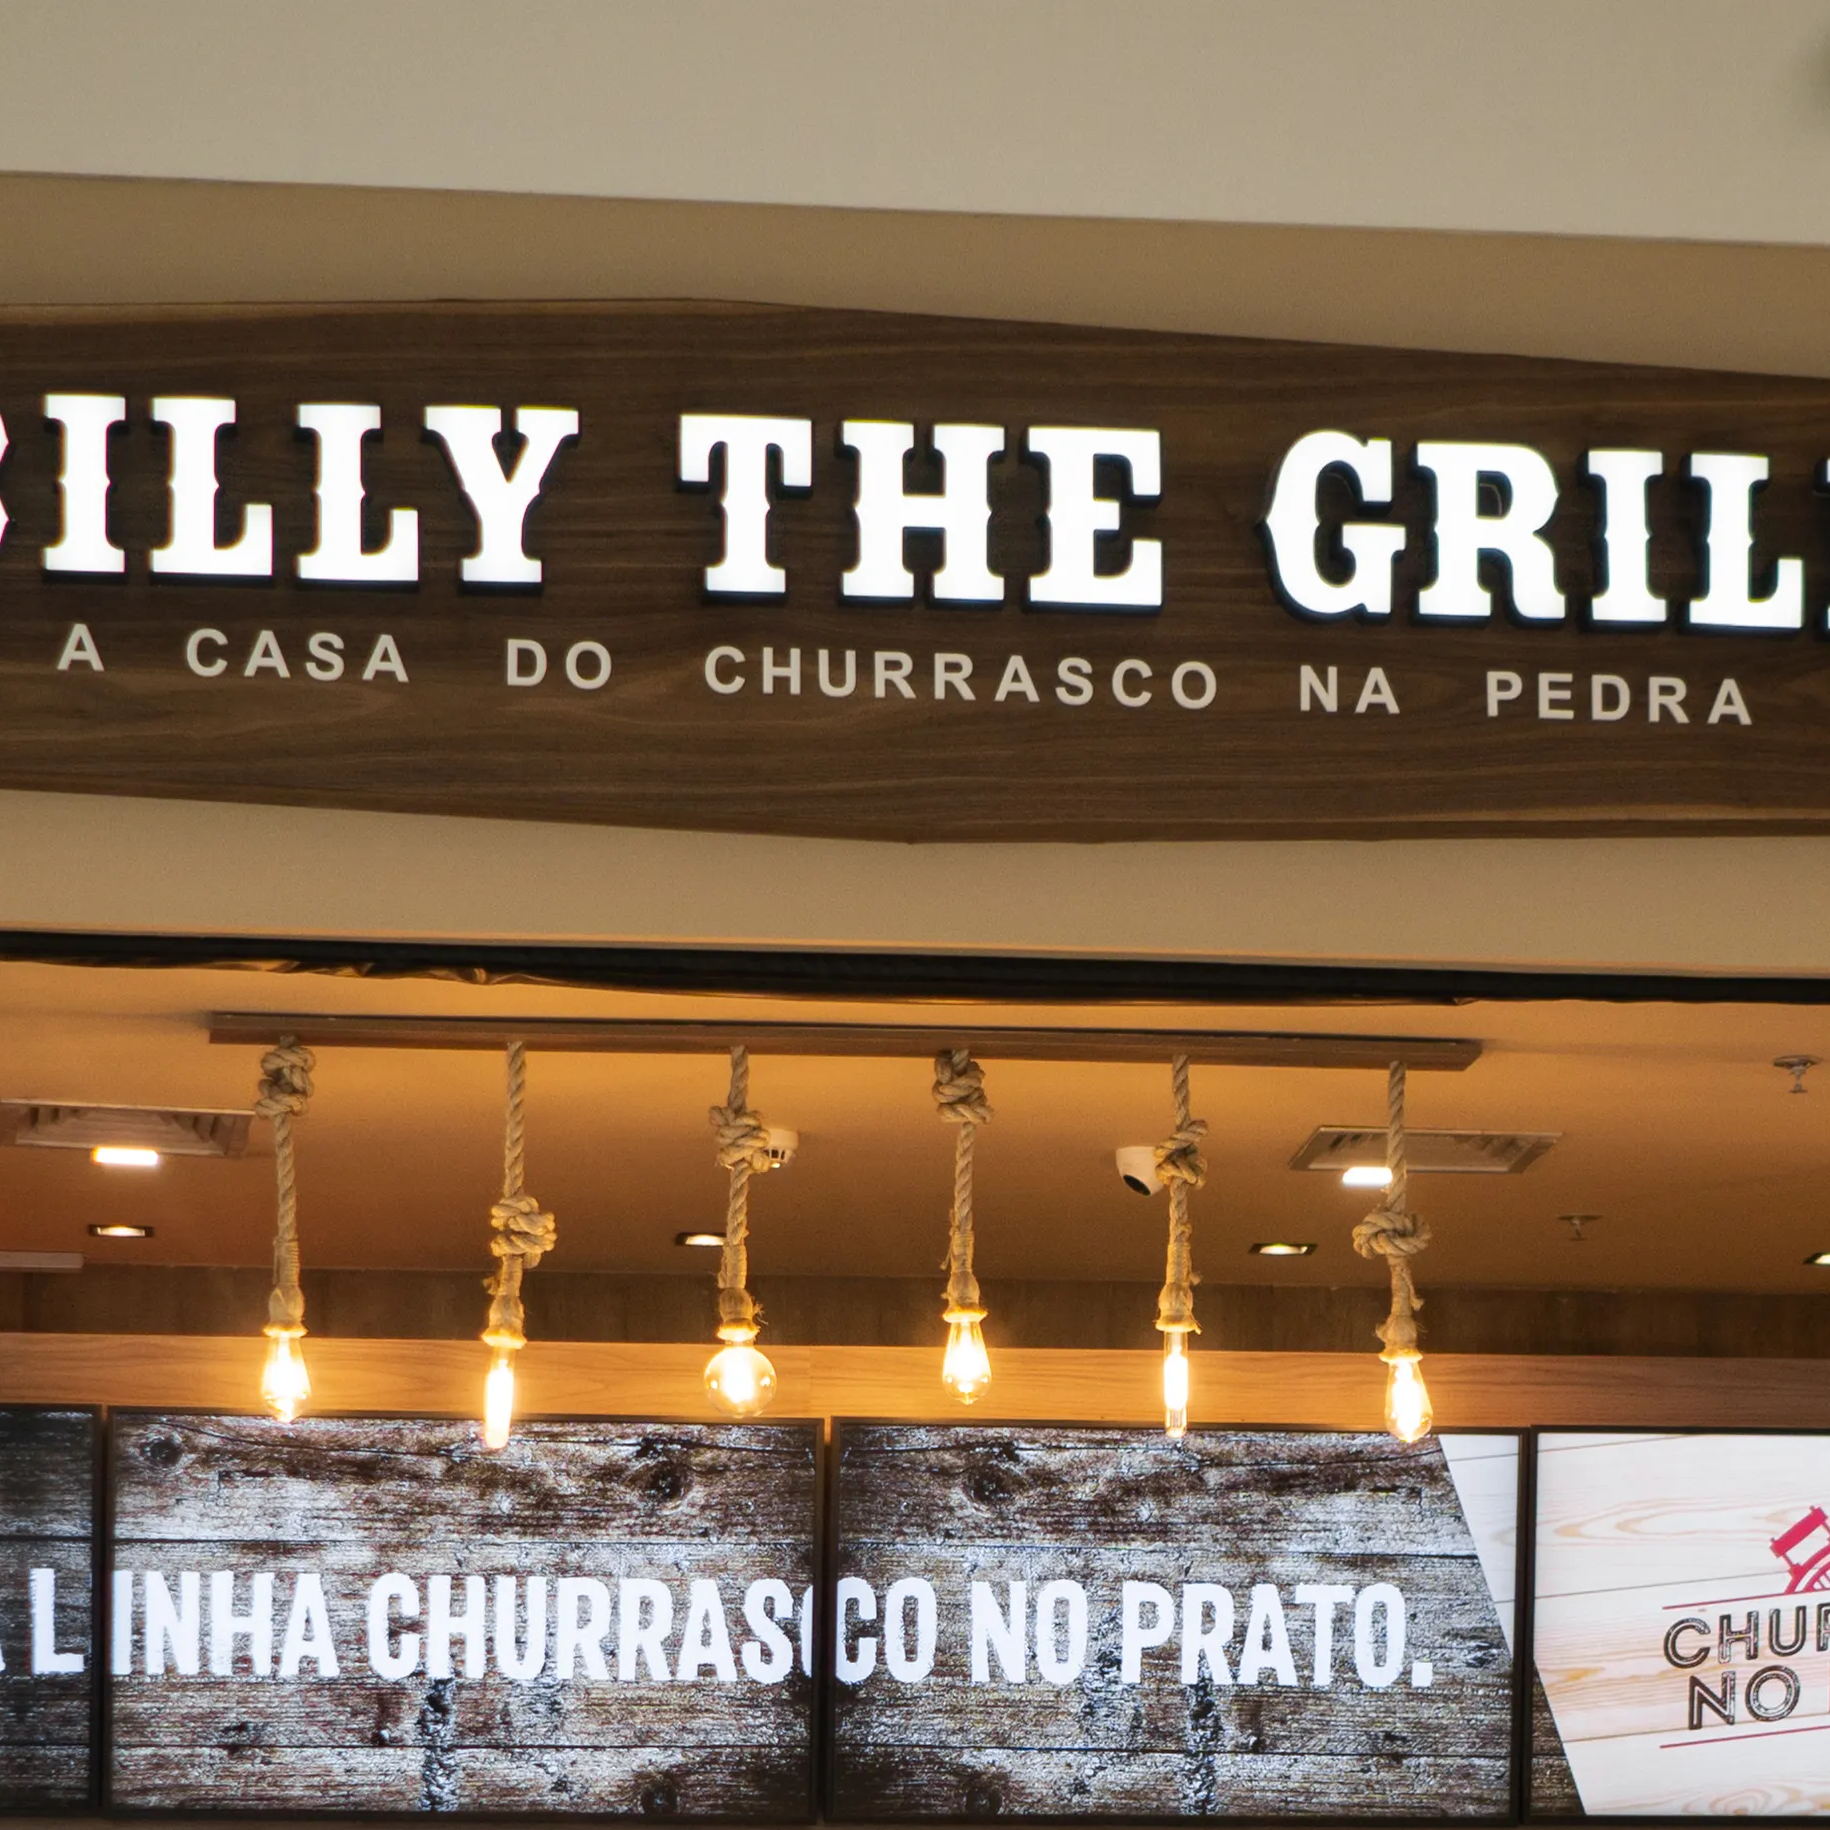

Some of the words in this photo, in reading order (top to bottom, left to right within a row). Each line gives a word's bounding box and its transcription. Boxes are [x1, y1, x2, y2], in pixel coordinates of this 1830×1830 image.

[679, 414, 1163, 608] THE
[57, 623, 104, 671] A
[185, 628, 409, 682] CASA
[507, 638, 613, 689] DO
[704, 646, 1217, 709] CHURRASCO
[1300, 665, 1400, 714] NA
[1487, 671, 1752, 725] PEDRA
[971, 1580, 1089, 1685] NO
[1121, 1581, 1431, 1688] PRATO.
[1687, 1663, 1801, 1730] NO
